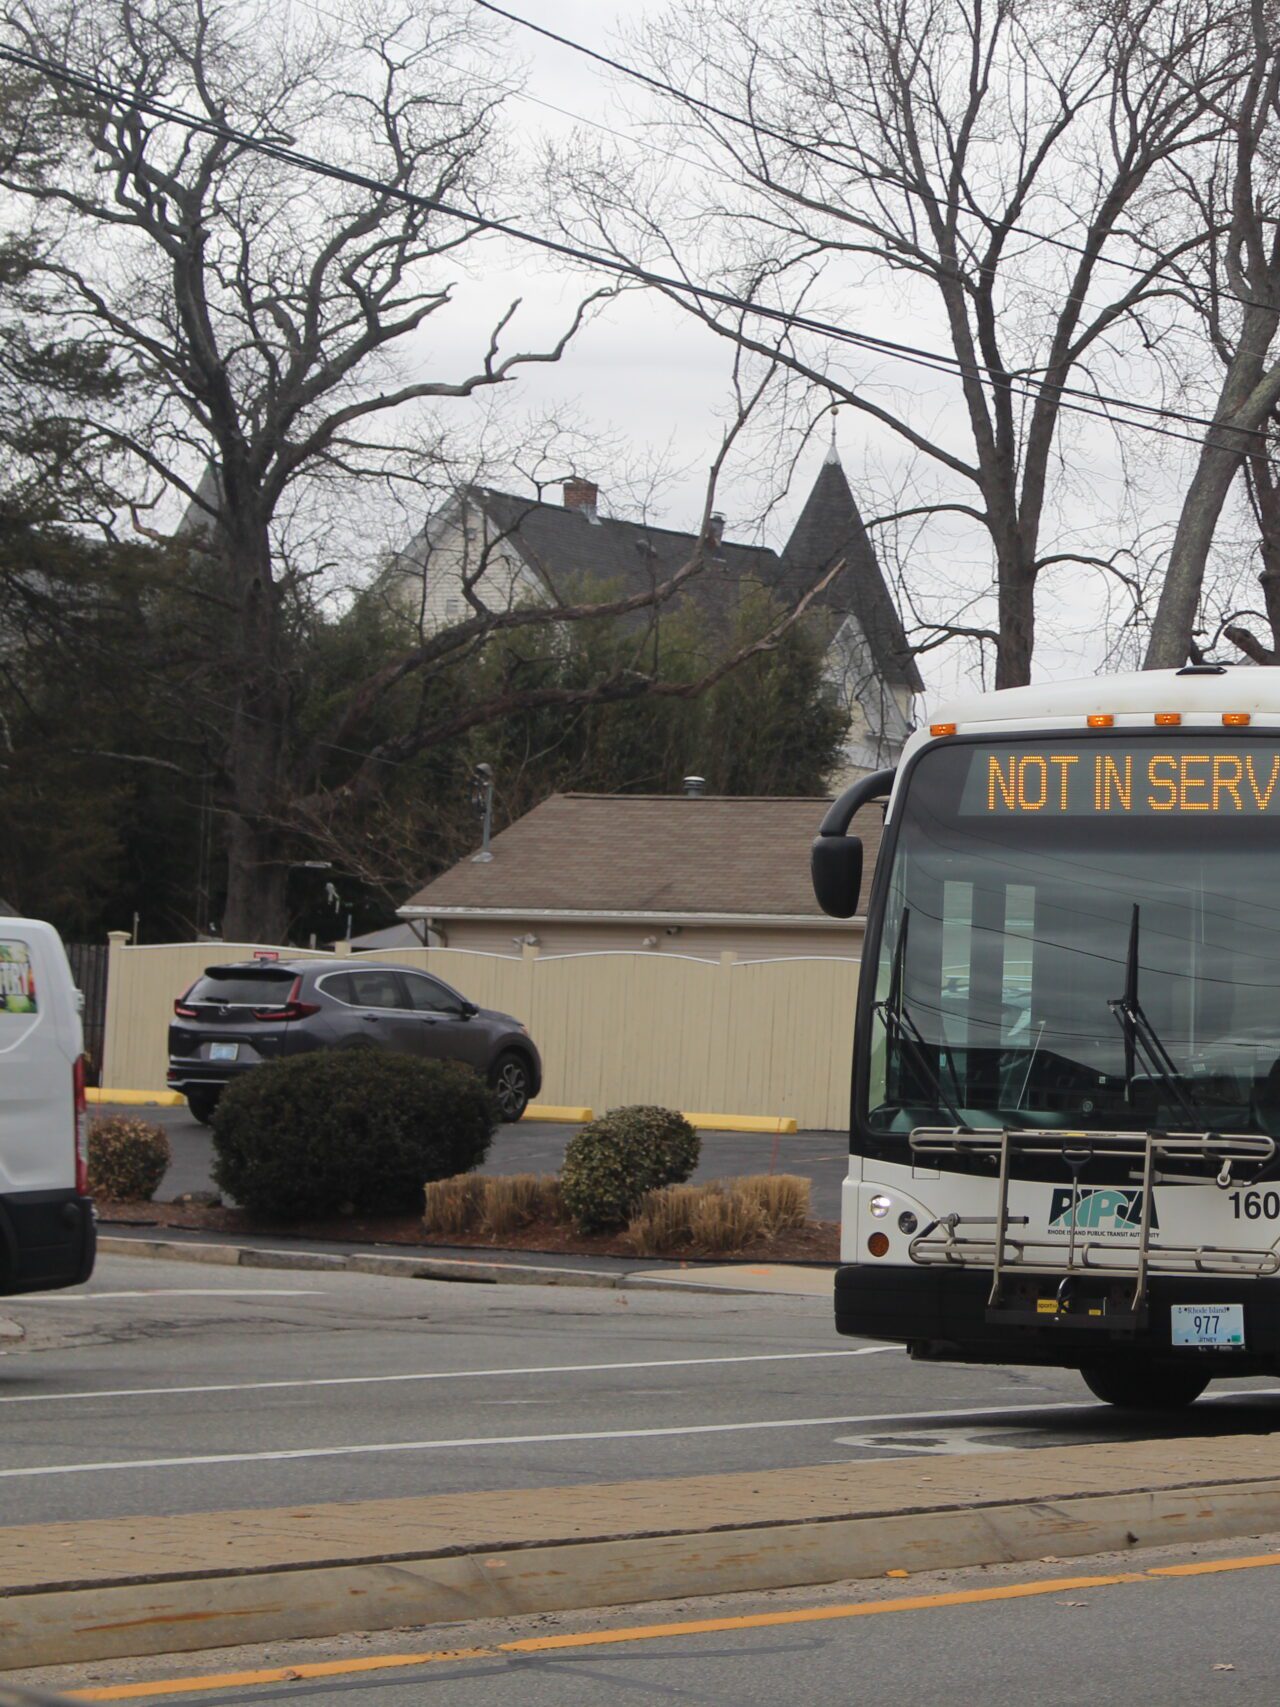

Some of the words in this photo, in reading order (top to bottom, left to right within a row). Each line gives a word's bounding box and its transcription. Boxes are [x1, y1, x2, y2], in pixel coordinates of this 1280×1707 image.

[987, 754, 1079, 811] NOT
[1094, 754, 1132, 811] IN
[1048, 1188, 1160, 1230] RIPTA
[1066, 1229, 1085, 1237] ISAND
[1087, 1230, 1106, 1238] PUBLIC
[1106, 1230, 1129, 1238] TRANSIT
[1208, 1306, 1227, 1314] Island
[1193, 1315, 1220, 1335] 977
